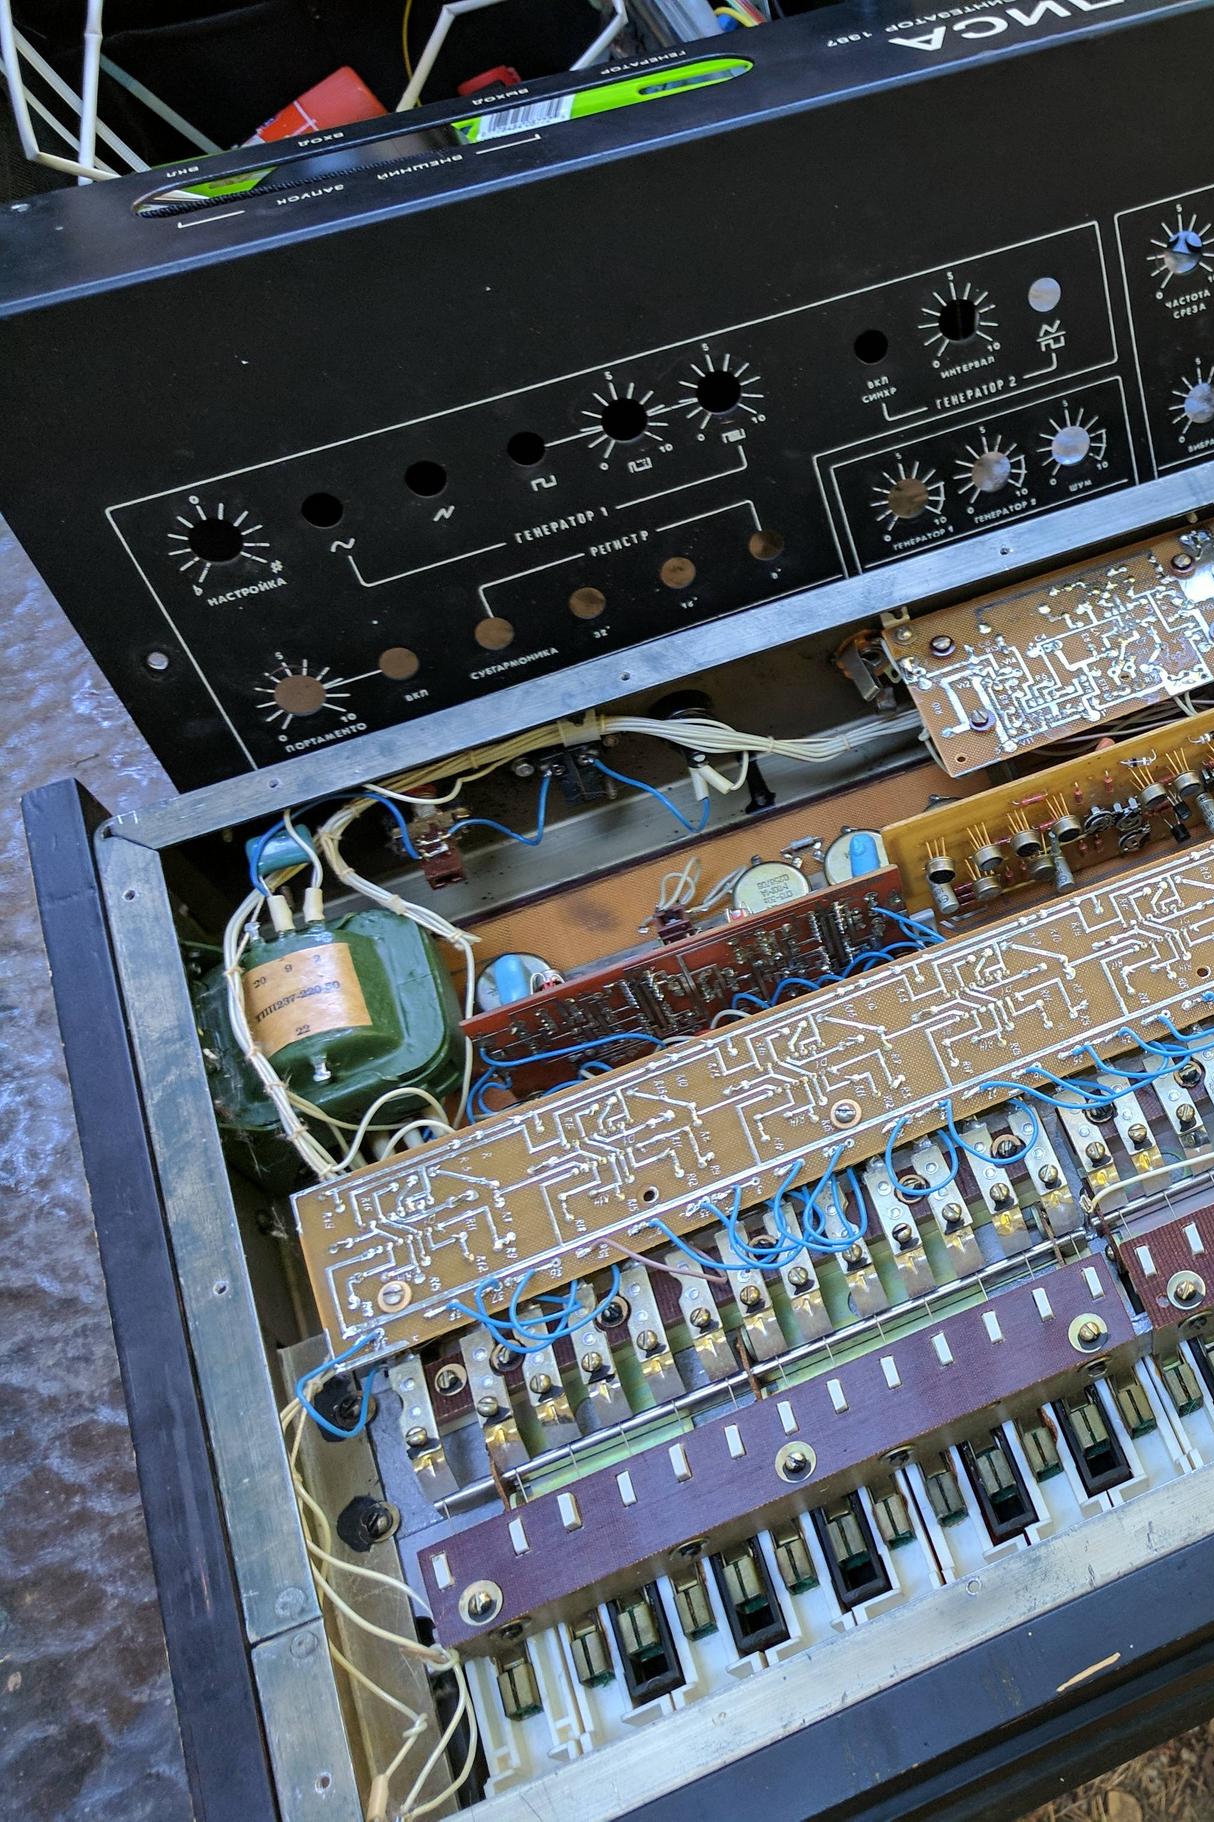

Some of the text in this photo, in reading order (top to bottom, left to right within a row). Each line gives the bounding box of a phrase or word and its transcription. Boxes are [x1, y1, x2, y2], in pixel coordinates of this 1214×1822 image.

[600, 50, 687, 75] ГЕНЕРАТОР
[472, 87, 529, 106] ВЫХОД
[298, 132, 344, 148] ВХОД
[166, 165, 199, 178] ВКЛ
[276, 154, 463, 206] ВНЕШНИЙ ЗАПУСК
[1176, 204, 1182, 212] 5
[947, 272, 954, 280] 5
[1165, 289, 1211, 310] ЧАСТОТА
[1173, 302, 1207, 319] СРЕЗА
[702, 343, 710, 351] 5
[987, 342, 1001, 352] 10
[932, 360, 940, 368] 0
[940, 356, 995, 379] ИНТЕРВАЛ
[604, 371, 613, 380] 5
[866, 376, 889, 390] ВКЛ
[862, 387, 897, 404] СИНХР
[935, 376, 1017, 410] ГЕНЕРАТОР 2
[751, 414, 766, 424] 10
[697, 433, 706, 442] 0
[659, 443, 673, 453] 10
[600, 462, 609, 470] 0
[1068, 479, 1092, 492] ШУМ
[189, 495, 199, 505] 0
[966, 506, 975, 515] 0
[974, 500, 1028, 524] ГЕНЕРАТОР
[514, 506, 608, 544] ГЕНЕРАТОР 1
[590, 530, 650, 557] РЕГИСТР
[884, 534, 892, 542] 0
[893, 525, 954, 550] ГЕНЕРАТОР 1
[207, 577, 288, 606] НАСТРОЙКА
[275, 652, 284, 660] 5
[469, 647, 560, 680] СУБГАРМОНИКА
[404, 688, 430, 702] ВКЛ
[285, 722, 368, 753] ПОРТАМЕНТО
[254, 976, 268, 989] 20
[314, 954, 321, 963] 2
[295, 1024, 311, 1036] 22
